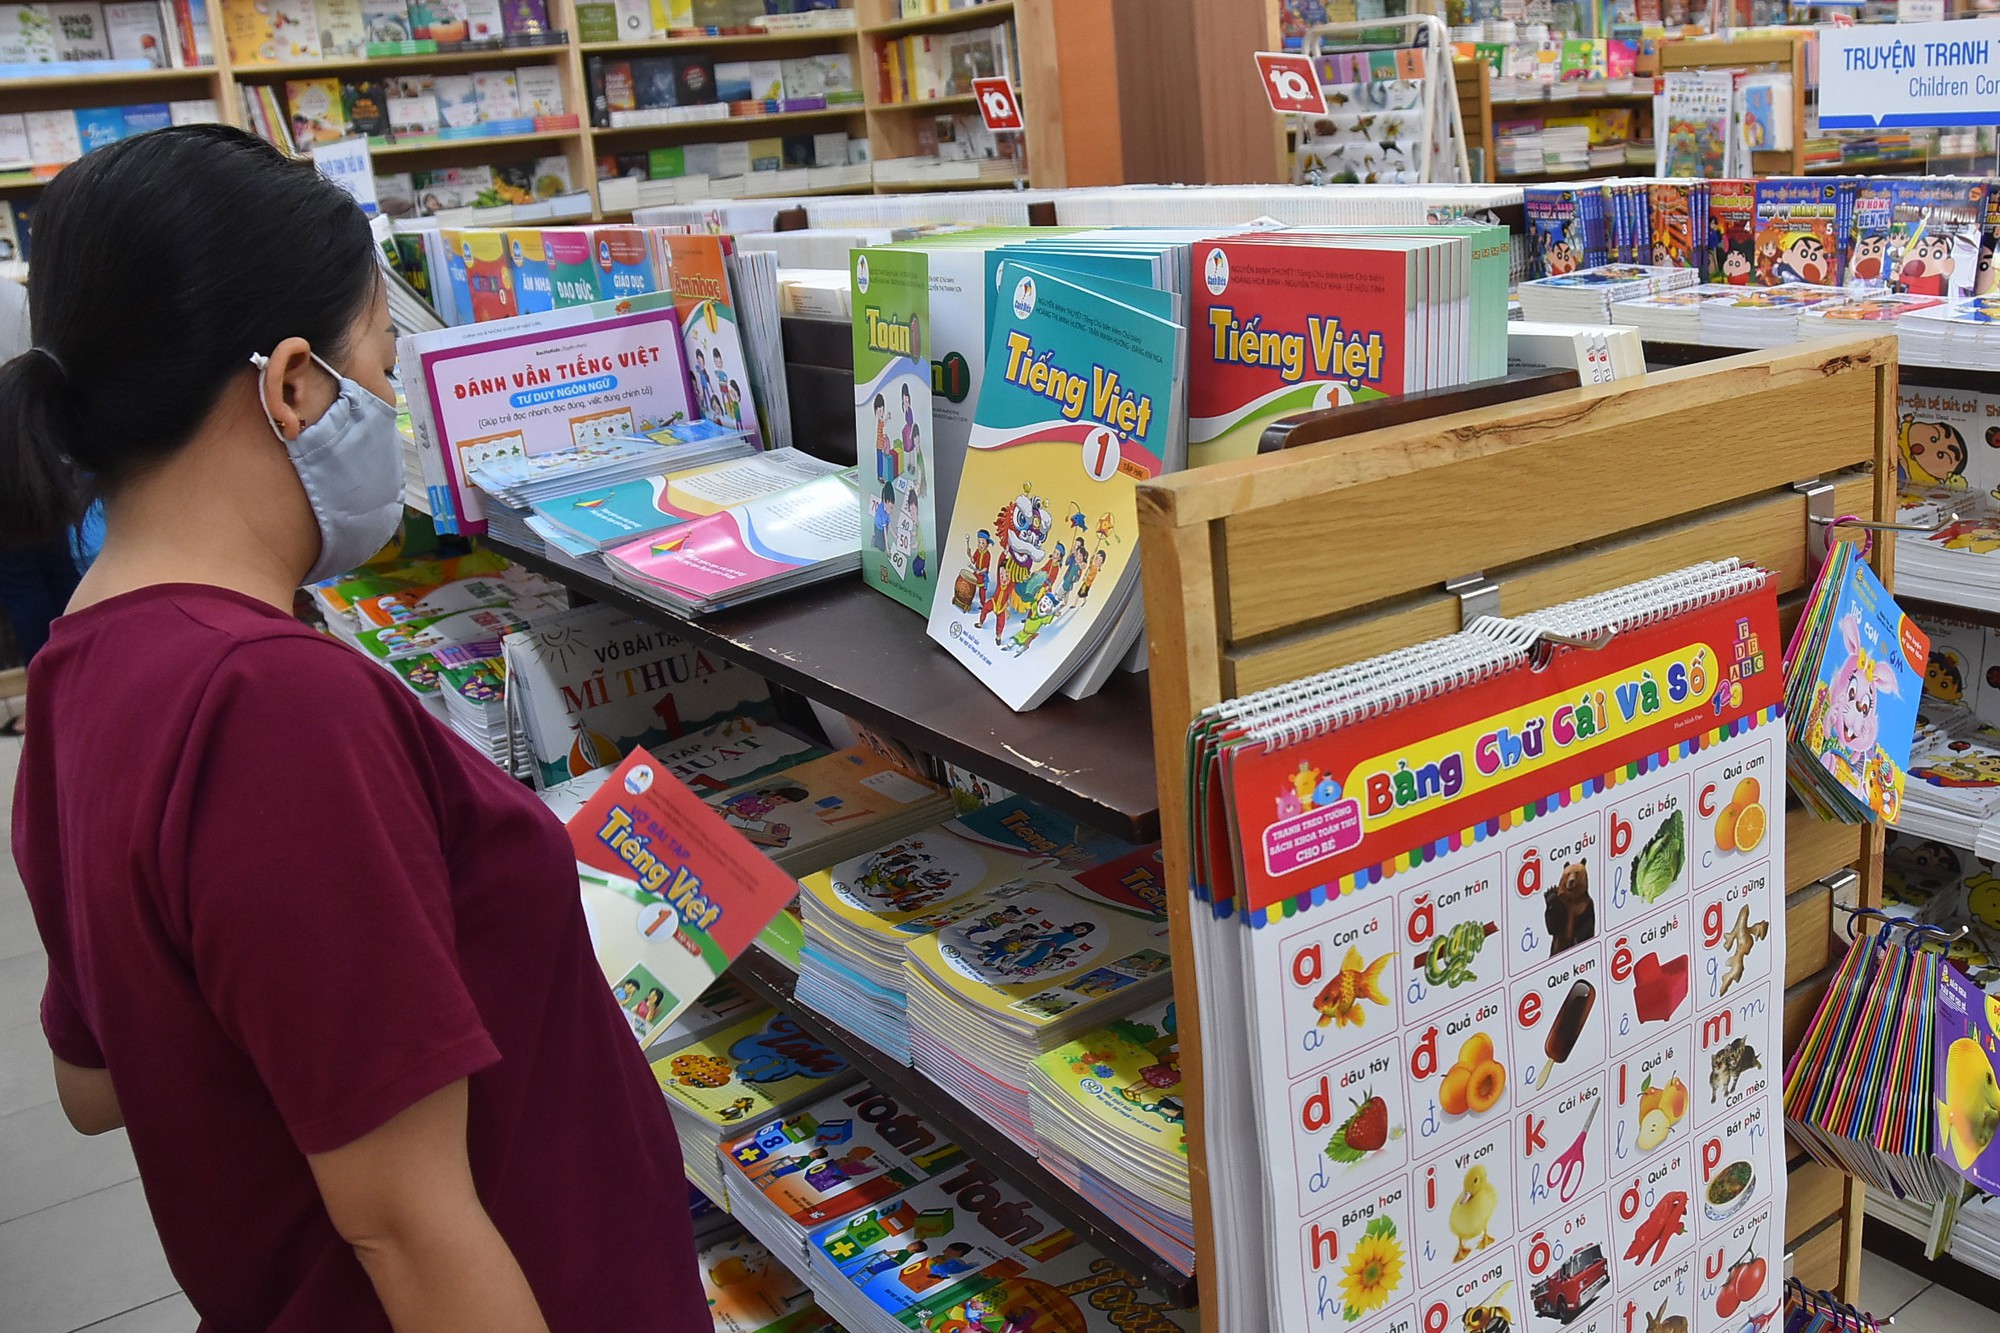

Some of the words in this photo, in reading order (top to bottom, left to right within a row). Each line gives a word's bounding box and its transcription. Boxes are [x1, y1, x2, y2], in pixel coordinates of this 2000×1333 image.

[1843, 39, 1915, 75] TRUYỆN
[1924, 40, 1989, 66] TRANH
[1909, 75, 1968, 97] Children
[1681, 224, 1687, 234] 3
[1744, 221, 1750, 231] 4
[1826, 223, 1833, 234] 5
[522, 272, 533, 291] ÂM
[534, 276, 550, 296] NHẠ
[557, 280, 575, 304] ĐẠO
[577, 277, 594, 301] ĐỨC
[613, 271, 630, 288] GIÁO
[674, 268, 692, 298] Âm
[693, 273, 721, 305] nhạc
[866, 308, 911, 353] Toán
[911, 317, 919, 358] 1
[1209, 307, 1305, 382] Tiếng
[1307, 316, 1384, 388] Việt
[454, 376, 506, 399] ĐÁNH
[512, 364, 550, 388] VẦN
[556, 353, 613, 379] TIẾNG
[618, 346, 659, 368] VIỆT
[948, 356, 960, 395] 1
[1004, 330, 1088, 420] Tiếng
[1092, 365, 1152, 440] Việt
[517, 394, 532, 405] TƯ
[534, 390, 555, 402] DUY
[556, 384, 587, 398] NGÔN
[588, 378, 610, 393] NGỮ
[1326, 386, 1340, 409] 1
[513, 409, 526, 421] đọc
[552, 404, 565, 416] đọc
[1095, 432, 1110, 477] 1
[898, 481, 905, 489] 10
[1133, 466, 1143, 478] HAI
[901, 519, 909, 531] 40
[899, 535, 909, 549] 50
[892, 552, 903, 567] 60
[1741, 624, 1748, 638] F
[595, 641, 620, 663] VỞ
[623, 634, 652, 657] BÀI
[1736, 645, 1744, 659] D
[1750, 640, 1757, 654] E
[1731, 666, 1739, 680] A
[1744, 662, 1751, 675] B
[1755, 657, 1763, 670] C
[560, 667, 612, 714] MĨ
[653, 692, 685, 740] 1
[1366, 760, 1463, 819] Bảng
[1474, 717, 1545, 777] Chữ
[1552, 691, 1608, 746] Cái
[1615, 671, 1660, 721] Và
[1668, 648, 1707, 702] Số
[672, 743, 702, 760] TẬP
[1723, 761, 1743, 780] Quả
[1745, 754, 1765, 771] cam
[1638, 802, 1655, 821] Cải
[1657, 795, 1677, 815] bắp
[1698, 783, 1716, 818] c
[1000, 808, 1058, 852] Tiếng
[1272, 824, 1301, 840] TRANH
[1302, 816, 1323, 829] THEO
[1324, 805, 1352, 821] TƯỜNG
[1294, 832, 1317, 846] KHOA
[1340, 816, 1357, 829] THƯ
[1610, 811, 1632, 859] b
[649, 822, 668, 842] BÀI
[668, 837, 690, 860] TẬP
[1295, 845, 1320, 862] CHO
[1321, 837, 1336, 853] BÉ
[1549, 843, 1572, 861] Con
[1574, 832, 1596, 855] gấu
[599, 805, 672, 891] Tiếng
[667, 866, 720, 930] Việt
[1437, 889, 1461, 908] Con
[1464, 878, 1489, 898] trăn
[1726, 886, 1738, 902] Củ
[1741, 875, 1765, 898] gừng
[644, 907, 672, 937] 1
[1333, 928, 1358, 947] Con
[1363, 918, 1378, 934] cá
[1408, 893, 1435, 943] ă
[1640, 929, 1657, 945] Cái
[1659, 914, 1679, 938] ghế
[1703, 901, 1723, 949] g
[1292, 943, 1322, 987] a
[1547, 971, 1570, 988] Que
[1572, 959, 1596, 977] kem
[1610, 937, 1633, 982] ê
[1446, 1013, 1471, 1035] Quả
[1475, 1004, 1498, 1022] đào
[1517, 992, 1542, 1028] e
[1702, 1009, 1732, 1051] m
[1410, 1026, 1439, 1080] đ
[1641, 1056, 1662, 1074] Quả
[1664, 1047, 1674, 1061] lê
[1340, 1069, 1366, 1088] dâu
[1369, 1057, 1390, 1076] tây
[1302, 1075, 1331, 1133] d
[1558, 1098, 1577, 1114] Cái
[1579, 1084, 1598, 1103] kéo
[1725, 1092, 1744, 1108] Con
[1745, 1079, 1766, 1099] mèo
[843, 1081, 936, 1156] Toán
[1726, 1120, 1742, 1137] Bát
[1744, 1108, 1761, 1128] phở
[762, 1135, 784, 1149] 8
[1524, 1113, 1547, 1158] k
[911, 1143, 961, 1169] 1
[1455, 1152, 1470, 1170] Vịt
[1473, 1142, 1494, 1160] con
[1702, 1137, 1722, 1184] p
[1426, 1166, 1435, 1210] i
[1647, 1166, 1668, 1184] Quả
[939, 1161, 1044, 1247] Toán
[1341, 1204, 1374, 1228] Bông
[1378, 1189, 1402, 1208] hoa
[857, 1226, 880, 1242] 8
[1564, 1218, 1573, 1235] Ô
[1576, 1213, 1586, 1230] tô
[1733, 1224, 1744, 1239] Cà
[1747, 1210, 1768, 1232] chua
[1020, 1228, 1077, 1257] 1
[1310, 1224, 1338, 1270] h
[1653, 1275, 1672, 1293] Con
[1674, 1264, 1689, 1280] thỏ
[1705, 1247, 1724, 1282] u
[1456, 1277, 1479, 1298] Con
[1481, 1264, 1503, 1286] ong
[1423, 1302, 1449, 1333] o
[1623, 1300, 1637, 1333] t
